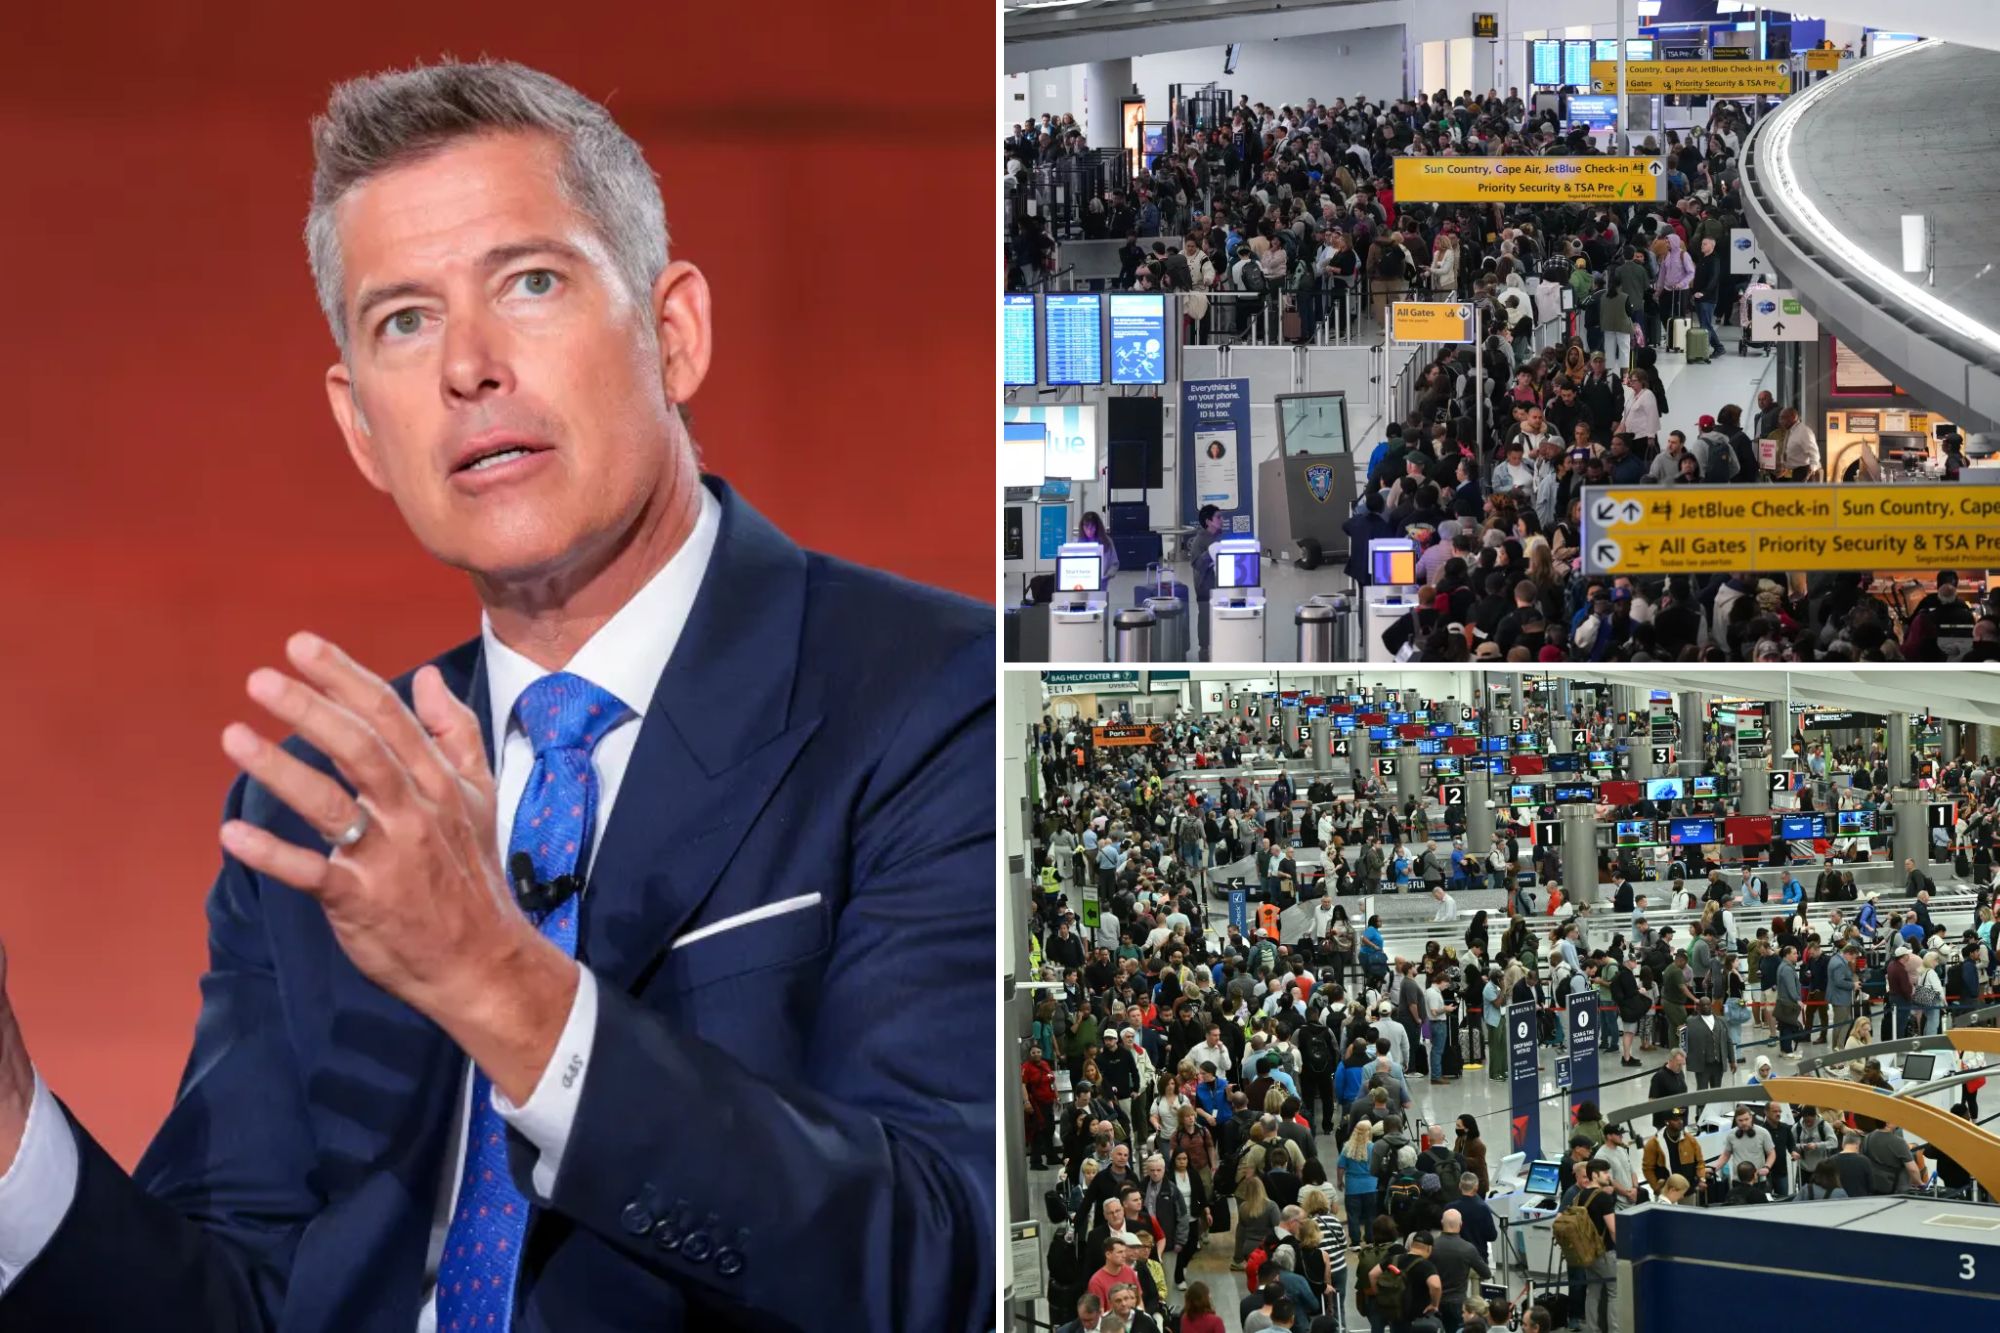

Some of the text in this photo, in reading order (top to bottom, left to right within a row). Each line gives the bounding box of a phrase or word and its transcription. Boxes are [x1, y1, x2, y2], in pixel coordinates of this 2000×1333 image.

[1629, 65, 1663, 75] Country,
[1665, 65, 1684, 75] Cape
[1700, 65, 1728, 74] JetBlue
[1729, 65, 1763, 74] Check-in
[1631, 79, 1652, 88] Gates
[1675, 79, 1704, 89] Priority
[1705, 79, 1737, 89] Security
[1746, 79, 1762, 87] TSA
[1764, 79, 1776, 87] Pre
[1424, 163, 1629, 176] Sun Country, Cape Air, JetBlue Check-in
[1478, 182, 1615, 195] Priority Security & TSA Pre
[1397, 308, 1435, 317] All Gates
[1191, 384, 1230, 393] Everything
[1198, 393, 1215, 403] your
[1216, 391, 1240, 401] phone.
[1215, 402, 1232, 410] your
[1308, 468, 1330, 477] POLICE
[1680, 500, 1829, 518] JetBlue Check-in
[1843, 498, 2000, 519] Sun Country, Cape
[1659, 538, 1747, 554] All Gates
[1759, 534, 2000, 556] Priority Security & TSA Pre
[1084, 673, 1110, 681] CENTER
[1047, 685, 1073, 694] ELTA
[1214, 693, 1220, 701] 9
[1388, 693, 1395, 702] 8
[1231, 699, 1237, 708] 8
[1422, 700, 1429, 709] 7
[1250, 707, 1256, 716] 7
[1462, 708, 1470, 718] 6
[1272, 716, 1279, 727] 6
[1512, 719, 1520, 731] 5
[1301, 728, 1309, 739] 5
[1574, 733, 1585, 744] 4
[1336, 741, 1347, 753] 4
[1448, 746, 1453, 754] 4
[1656, 749, 1666, 762] 3
[1382, 760, 1392, 774] 3
[1511, 766, 1517, 775] 3
[1774, 773, 1785, 790] 2
[1449, 788, 1462, 804] 2
[1602, 795, 1609, 804] 2
[1937, 807, 1945, 826] 1
[1545, 824, 1553, 844] 1
[1727, 833, 1734, 844] 1
[1576, 996, 1591, 1004] DELTA
[1520, 1025, 1526, 1036] 2
[1959, 1254, 1976, 1281] 3
